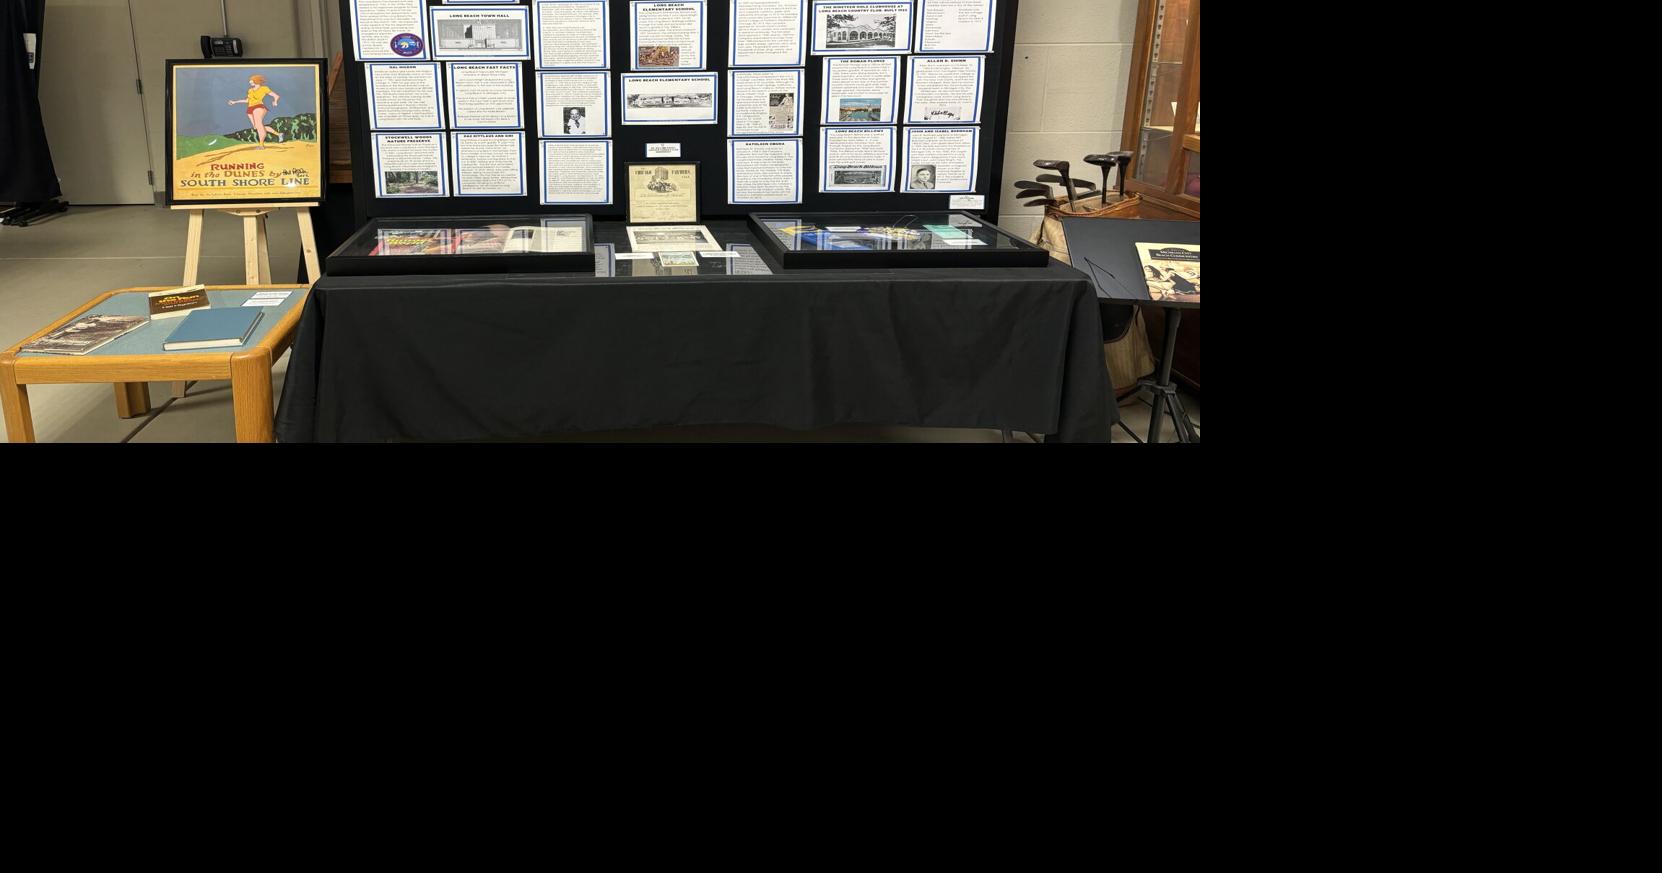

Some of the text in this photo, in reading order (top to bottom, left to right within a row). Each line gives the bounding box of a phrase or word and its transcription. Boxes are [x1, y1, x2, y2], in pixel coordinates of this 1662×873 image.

[224, 170, 265, 178] DUNES
[180, 178, 310, 187] SOUTH SHORE LINE
